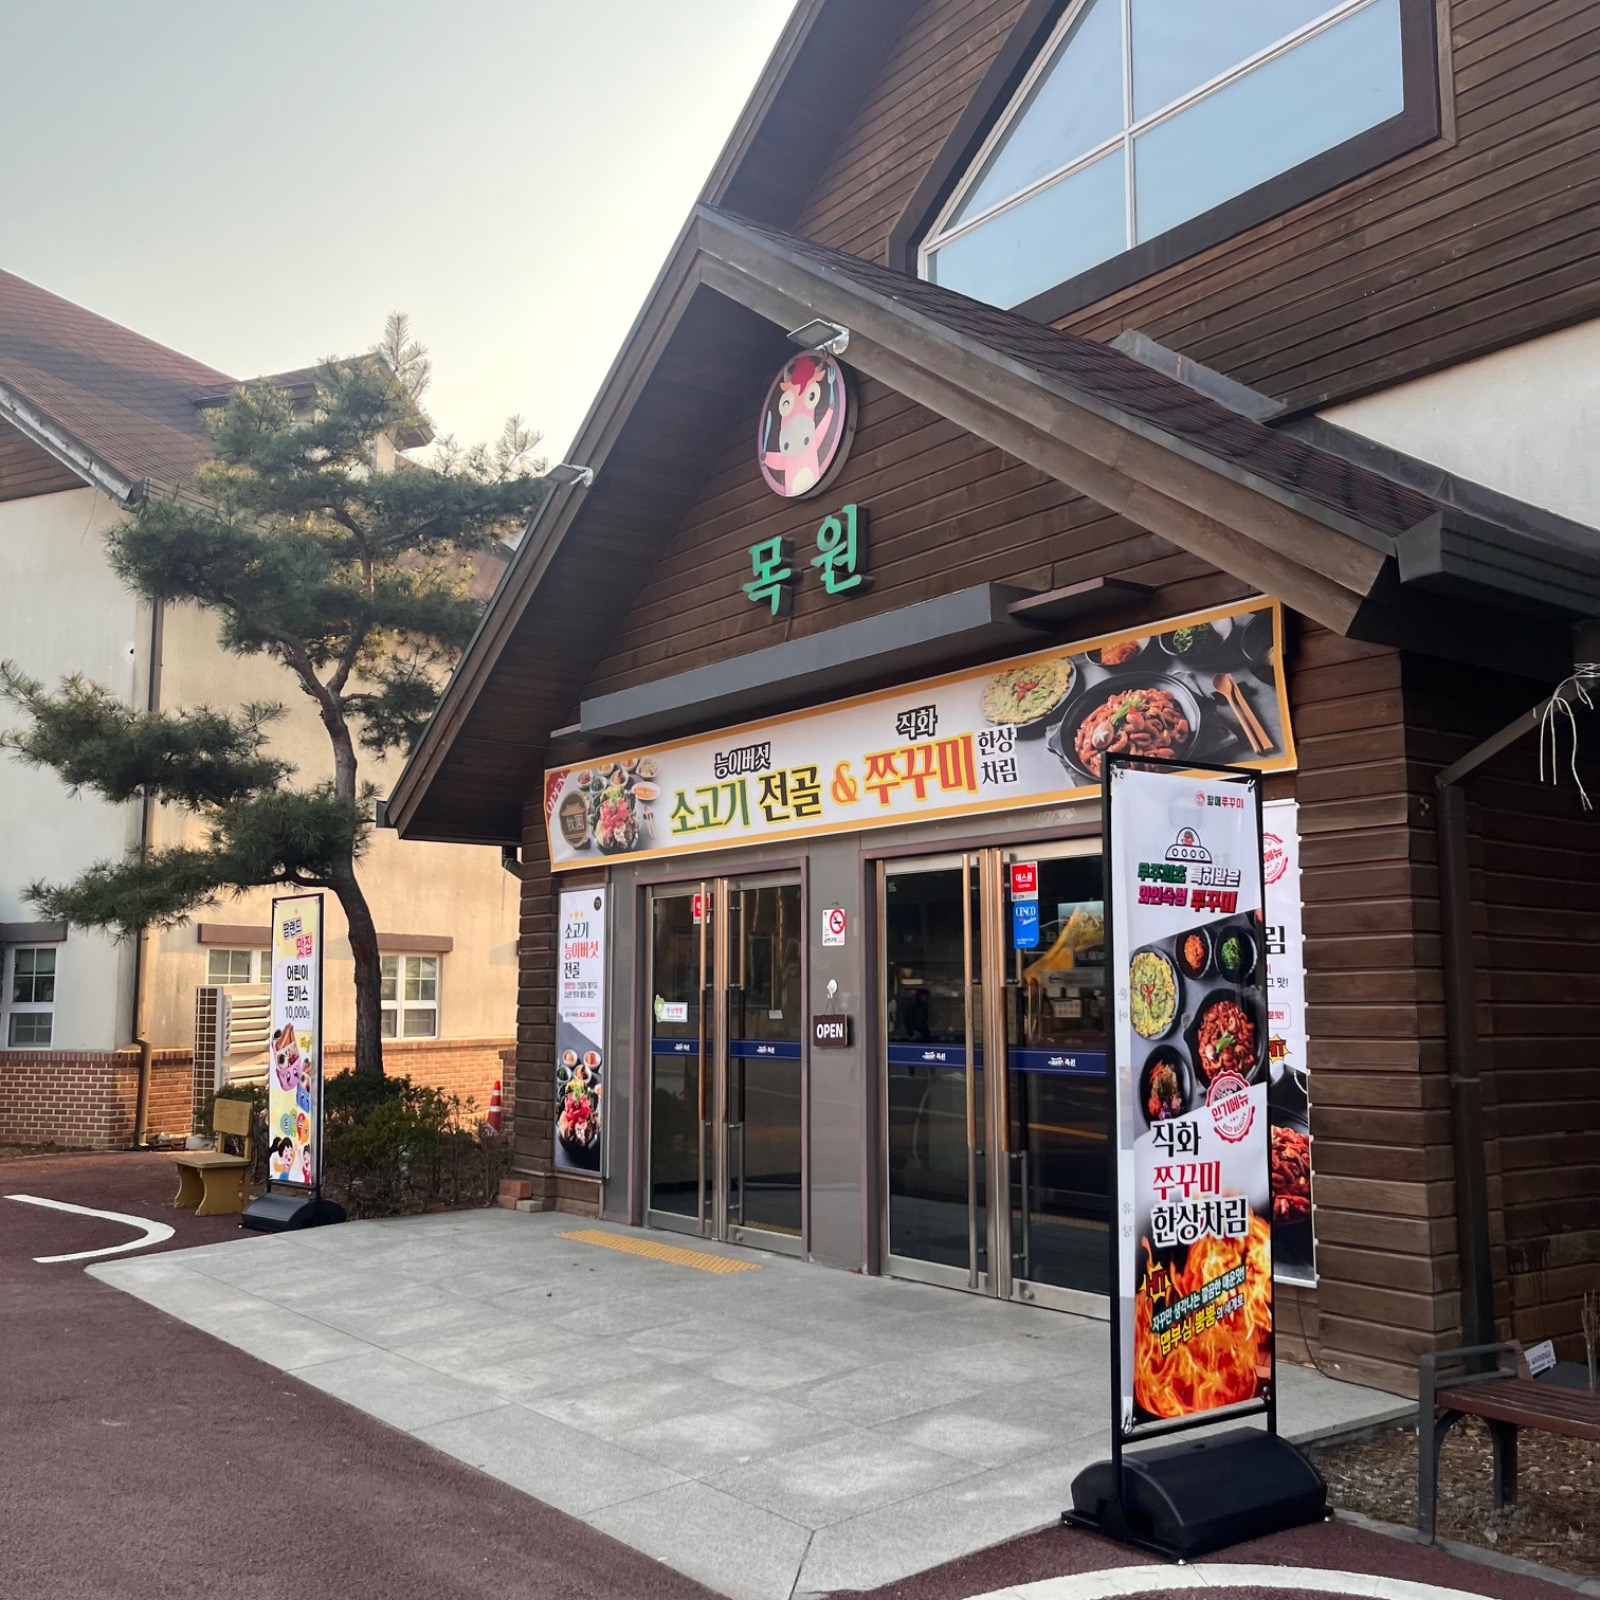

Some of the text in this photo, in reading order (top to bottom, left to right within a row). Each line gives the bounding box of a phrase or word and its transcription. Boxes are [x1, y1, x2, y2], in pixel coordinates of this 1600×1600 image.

[896, 705, 938, 740] 직화
[978, 727, 1018, 756] 한상
[714, 741, 771, 779] 능이버섯
[981, 757, 1018, 785] 차림
[546, 772, 566, 814] OPEN
[671, 734, 978, 835] 소고기 전골 & 쭈꾸미
[564, 921, 589, 939] 소고기
[564, 941, 599, 960] 능이버섯
[287, 965, 309, 981] 어린이
[564, 961, 580, 979] 전골
[287, 986, 309, 1001] 돈까스
[816, 1023, 843, 1038] OPEN
[1211, 1094, 1249, 1122] 인기메뉴
[1152, 1121, 1201, 1157] 직화
[1153, 1161, 1221, 1200] 쭈꾸미
[1152, 1198, 1247, 1244] 한상차림
[1146, 1270, 1167, 1297] HIT
[1152, 1307, 1173, 1331] 자꾸만
[1174, 1292, 1200, 1320] 생각나는
[1160, 1317, 1192, 1355] 맵부심
